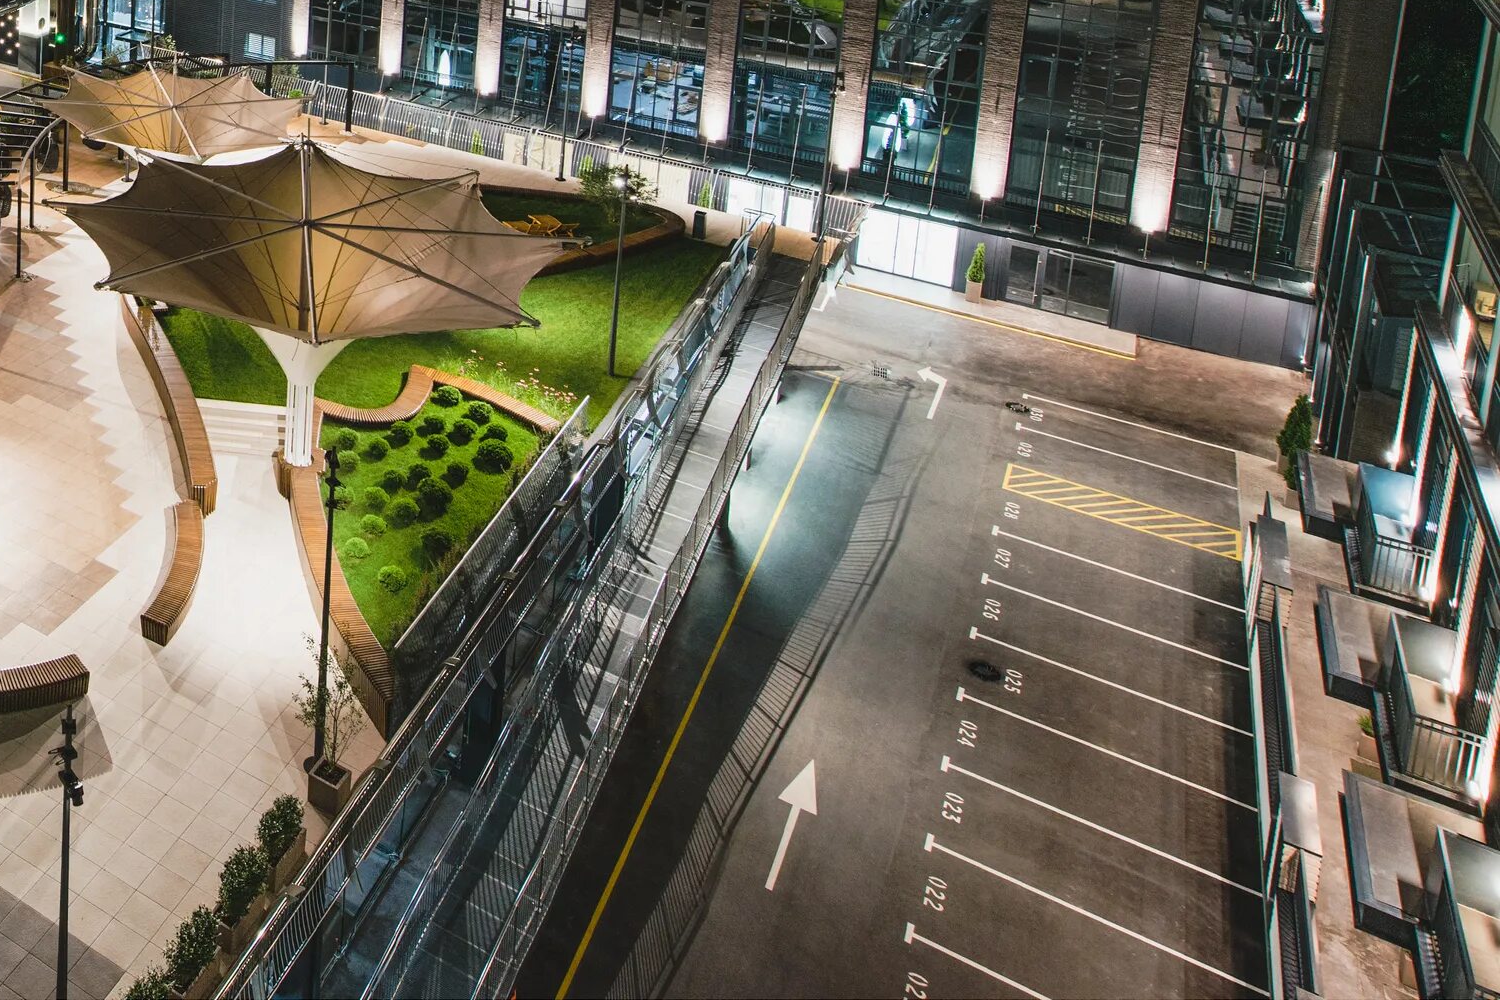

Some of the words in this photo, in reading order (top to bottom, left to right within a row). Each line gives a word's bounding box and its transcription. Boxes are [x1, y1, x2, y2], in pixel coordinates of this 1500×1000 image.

[1030, 407, 1044, 422] 030
[1016, 441, 1033, 458] 029
[1004, 501, 1021, 520] 028
[994, 548, 1011, 569] 027
[983, 598, 1002, 621] 026
[1004, 668, 1023, 695] 025
[957, 720, 978, 748] 024
[942, 792, 965, 824] 023
[923, 875, 948, 912] 022
[903, 972, 929, 1000] 02
